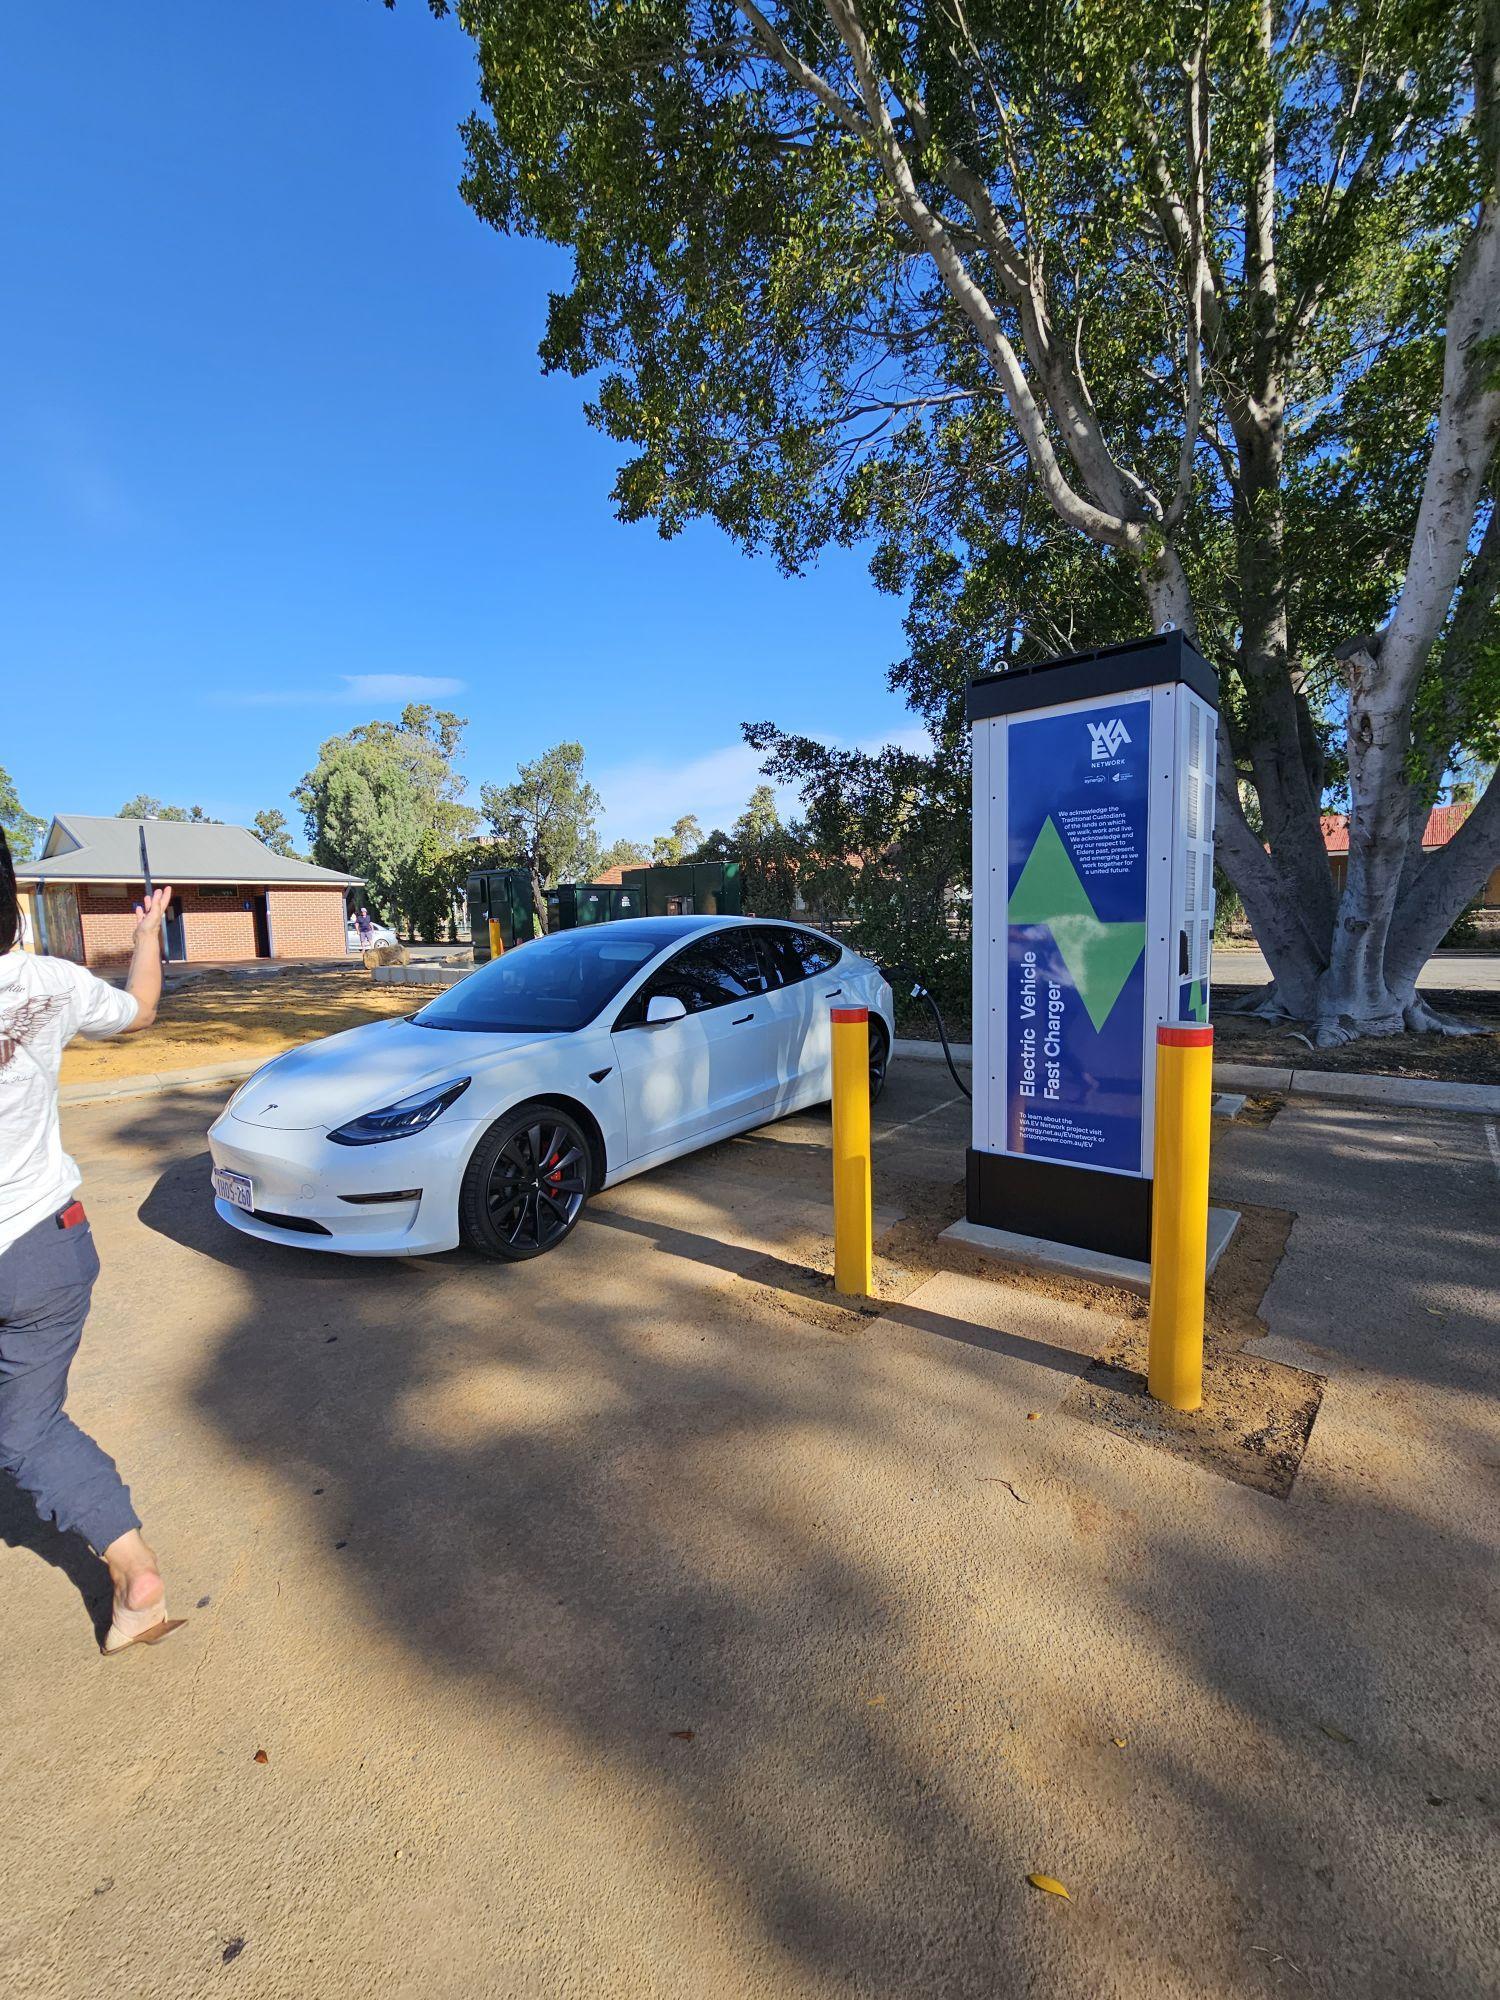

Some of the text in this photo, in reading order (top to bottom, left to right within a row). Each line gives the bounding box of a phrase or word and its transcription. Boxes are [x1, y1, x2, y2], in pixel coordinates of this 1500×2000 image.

[1086, 718, 1133, 744] WA
[1091, 736, 1123, 760] EV
[1091, 758, 1126, 769] NETWORK
[1069, 807, 1108, 816] acknowledge
[1061, 812, 1126, 823] Traditional Custodians
[1081, 833, 1121, 842] acknowledge
[1095, 840, 1119, 848] respect
[1076, 848, 1095, 856] Elders
[1110, 846, 1135, 854] present
[1091, 853, 1120, 861] emerging
[1097, 860, 1124, 869] together
[1019, 951, 1037, 1098] Electric Vehicle
[1043, 980, 1065, 1101] Fast Charger
[1019, 1111, 1073, 1125] To learn about the
[1019, 1118, 1030, 1126] WA
[1040, 1121, 1066, 1131] Network
[1066, 1125, 1089, 1134] project
[1089, 1128, 1103, 1136] visit
